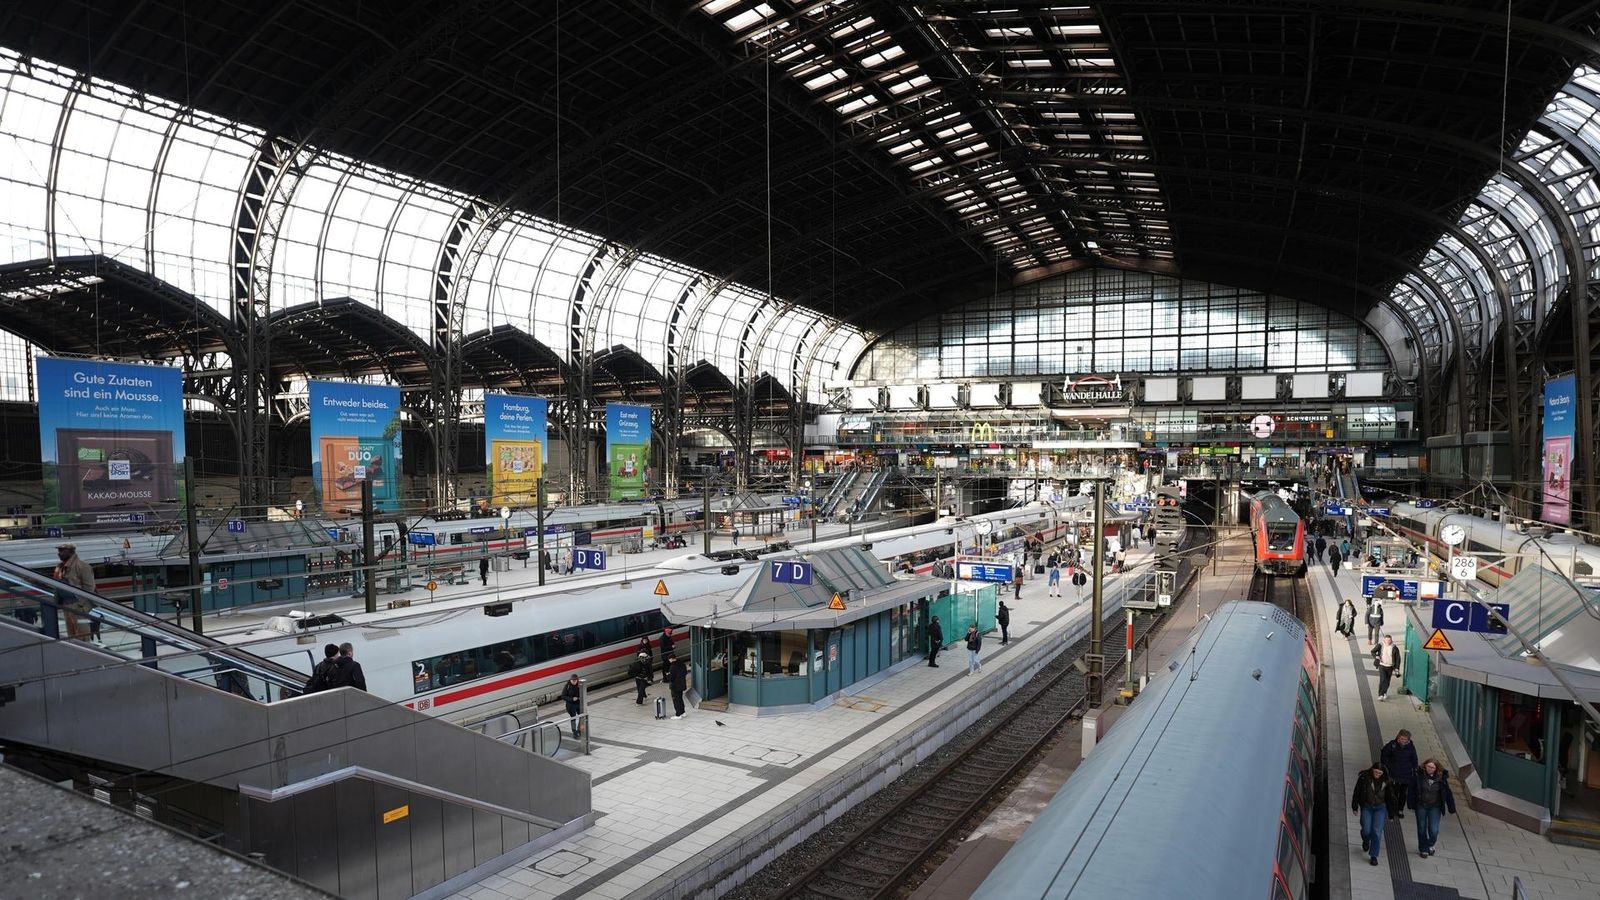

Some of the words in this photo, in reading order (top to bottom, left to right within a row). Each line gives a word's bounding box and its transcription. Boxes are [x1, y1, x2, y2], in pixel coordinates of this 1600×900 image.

[74, 371, 105, 385] Gute
[108, 374, 152, 387] Zutaten
[64, 387, 90, 399] sind
[94, 389, 112, 400] ein
[115, 390, 162, 402] Mousse.
[1063, 391, 1122, 400] WANDELHALLE
[323, 396, 360, 408] Entweder
[362, 398, 389, 409] beides.
[503, 403, 530, 414] Hamburg,
[499, 412, 515, 421] deine
[348, 451, 372, 461] DUO
[87, 490, 152, 500] KAKAO-MOUSSE
[237, 521, 242, 530] D
[578, 551, 586, 564] D
[594, 552, 602, 566] 8
[1455, 557, 1475, 568] 286
[774, 562, 783, 578] 7
[793, 564, 803, 579] D
[1460, 567, 1468, 577] 6
[1445, 602, 1465, 624] C
[417, 663, 426, 675] 2
